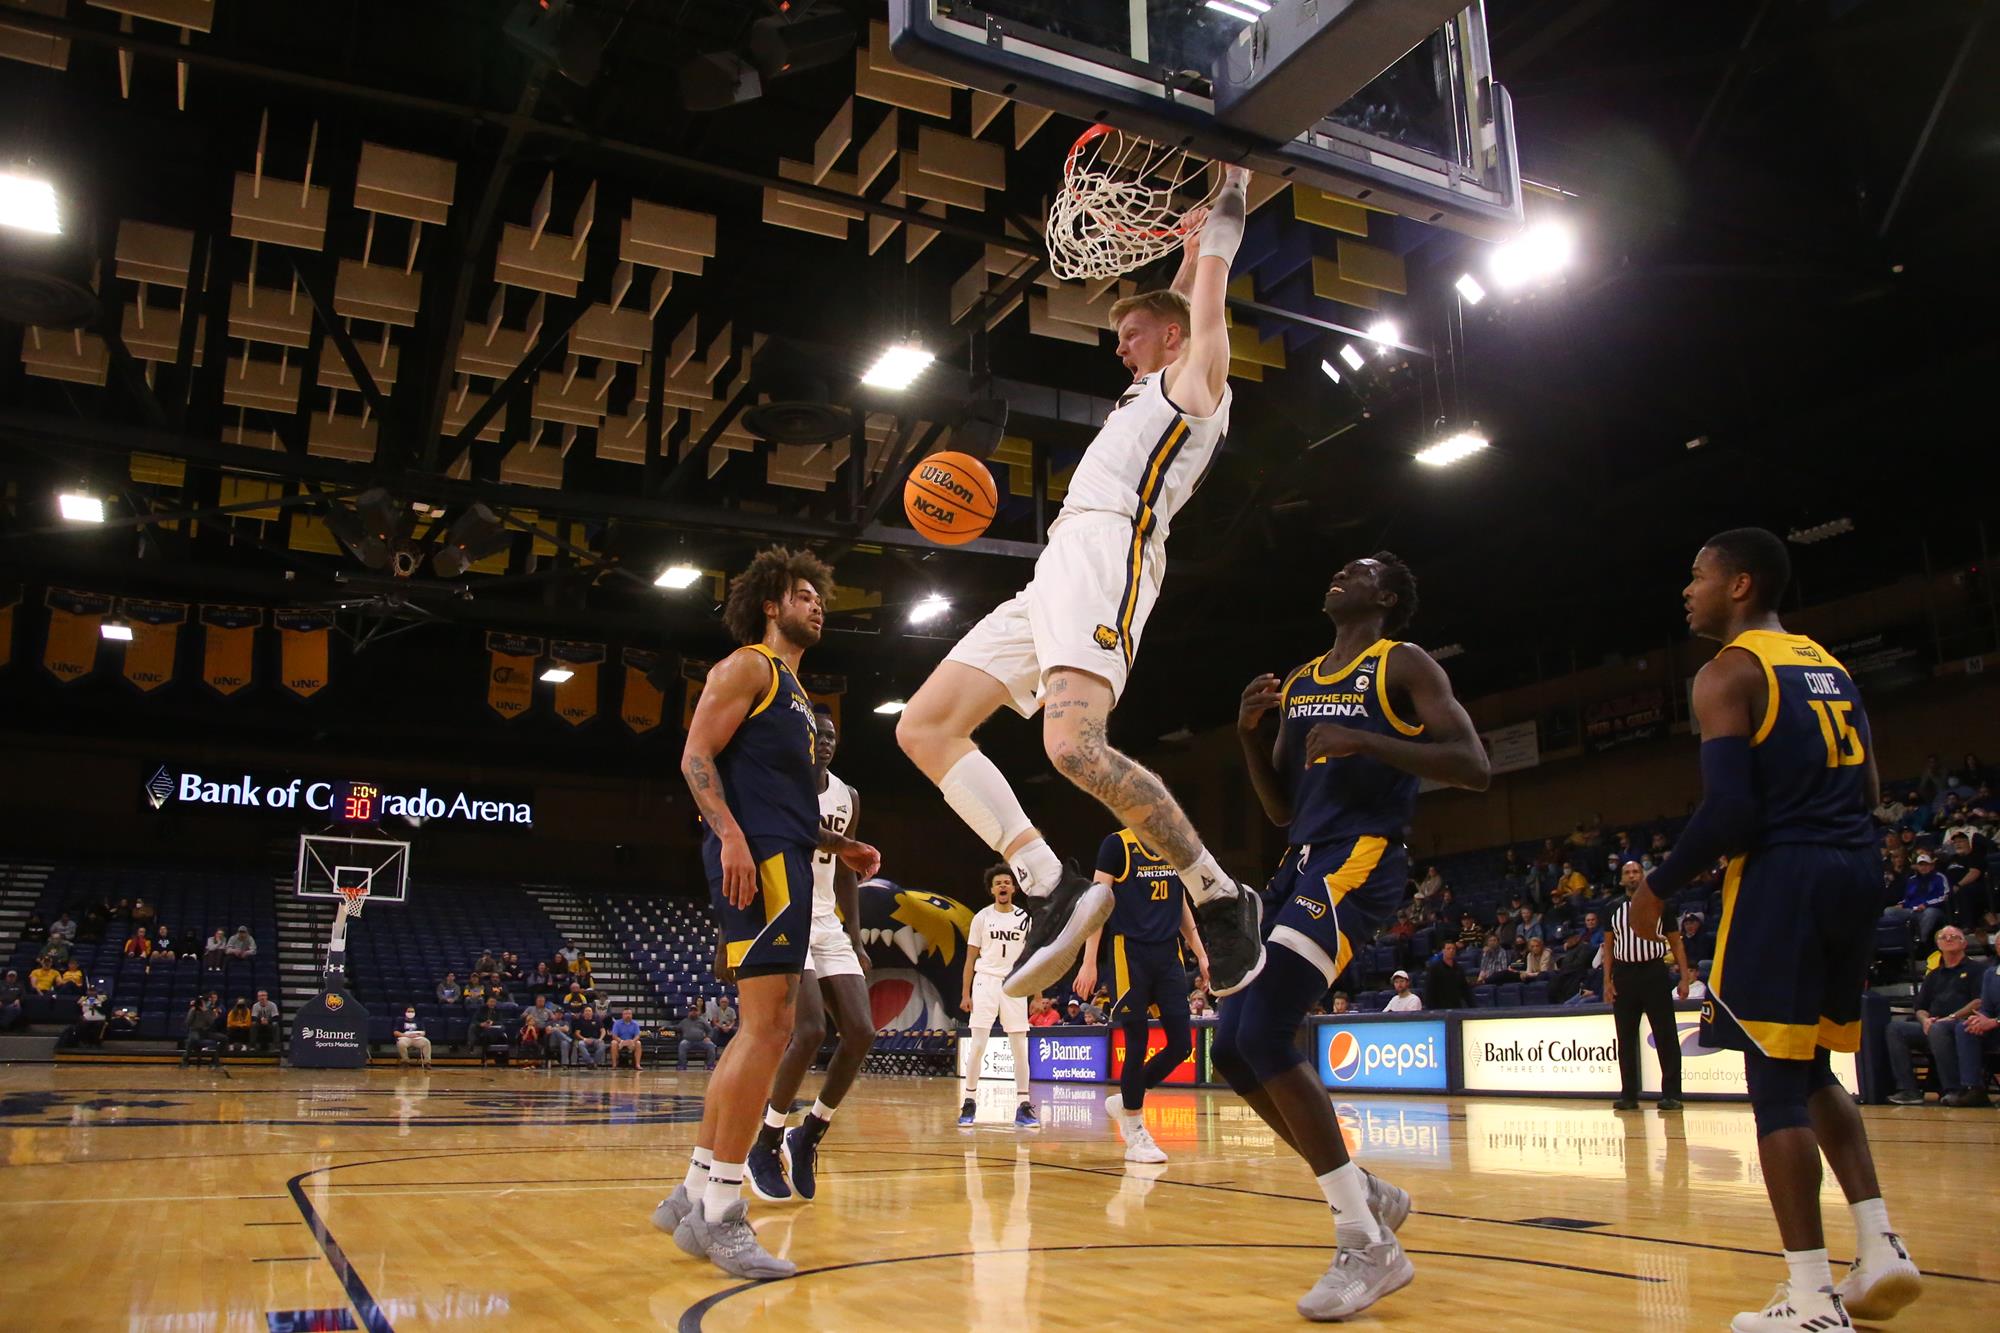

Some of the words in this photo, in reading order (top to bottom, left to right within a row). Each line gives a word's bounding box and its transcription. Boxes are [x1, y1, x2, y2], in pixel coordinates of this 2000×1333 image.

[920, 466, 974, 504] Wilson
[914, 496, 955, 524] NCAA
[51, 661, 84, 675] UNC
[131, 672, 162, 684] UNC
[212, 676, 241, 687] UNC
[290, 680, 319, 690] UNC
[1804, 672, 1840, 695] CONE
[496, 701, 521, 712] UNC
[1290, 694, 1365, 706] NORTHERN
[562, 708, 588, 719] UNC
[1287, 703, 1369, 720] ARIZONA
[1807, 700, 1865, 768] 15
[180, 773, 262, 806] Bank
[267, 779, 301, 809] of
[306, 782, 446, 818] Crado
[448, 792, 533, 824] Arena
[353, 786, 377, 803] 1:04
[345, 799, 370, 819] 30
[820, 814, 846, 832] NC
[1136, 870, 1178, 878] ARIZONA
[1151, 880, 1169, 901] 20
[1296, 898, 1321, 914] NAU
[990, 930, 1020, 941] UNC
[1002, 943, 1006, 958] 1
[315, 1028, 356, 1040] Banner
[994, 1052, 1014, 1062] Protec
[1052, 1041, 1092, 1061] Banner
[1485, 1041, 1523, 1066] Bank
[1528, 1040, 1543, 1066] of
[1548, 1039, 1619, 1066] Colorad
[993, 1063, 1015, 1075] Special
[1052, 1066, 1072, 1080] Sports
[1072, 1067, 1096, 1079] Medicine
[1500, 1065, 1545, 1073] THERE'S
[1553, 1065, 1579, 1074] ONLY
[1590, 1065, 1612, 1074] ONE
